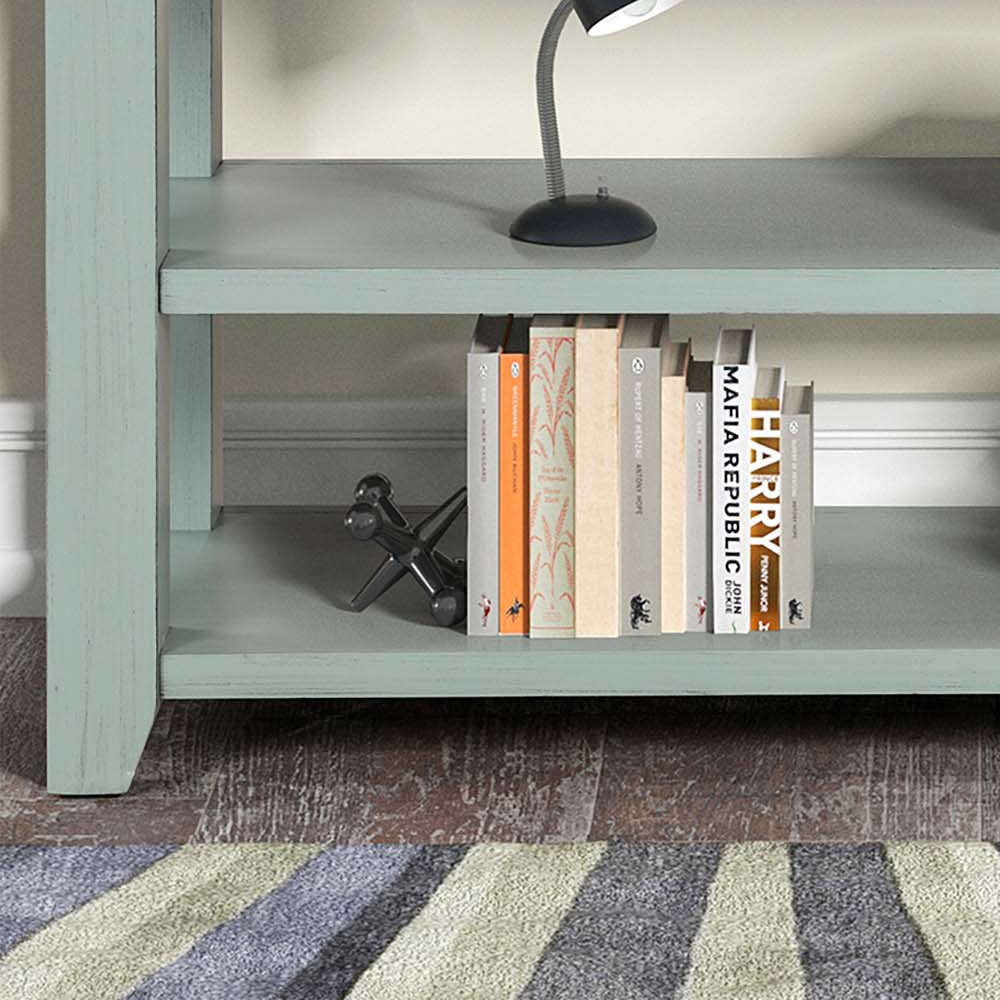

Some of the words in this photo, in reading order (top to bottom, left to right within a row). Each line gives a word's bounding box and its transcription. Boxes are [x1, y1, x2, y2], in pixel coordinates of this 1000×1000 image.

[723, 366, 739, 445] MAFIA
[750, 410, 781, 557] HARRY
[723, 453, 740, 574] REPUBLIC
[758, 554, 769, 584] PENNY
[724, 580, 732, 615] DICKIE
[732, 581, 741, 615] JOHN
[758, 583, 769, 613] JUNIOR
